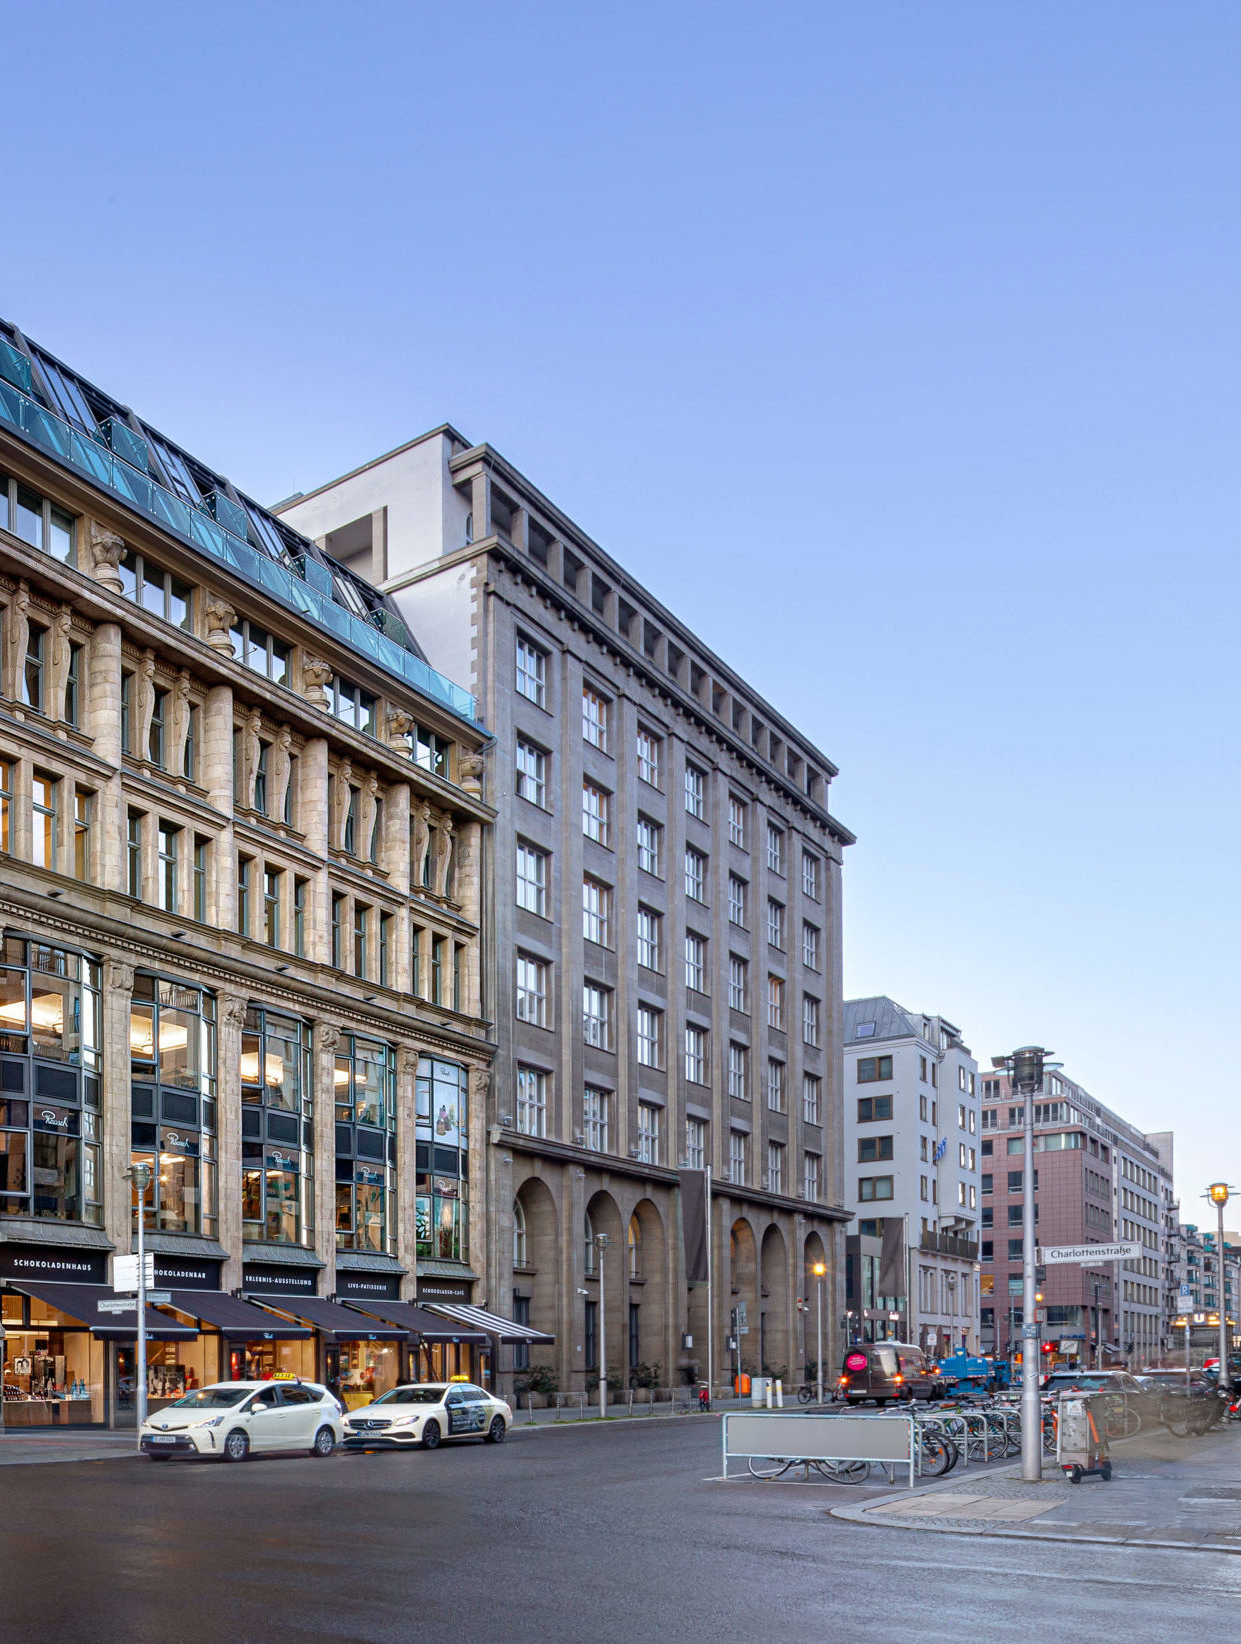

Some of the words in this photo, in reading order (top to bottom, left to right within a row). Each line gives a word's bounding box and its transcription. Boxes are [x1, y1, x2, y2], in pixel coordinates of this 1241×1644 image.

[41, 1110, 69, 1128] Rausch
[166, 1132, 190, 1148] Rausch
[1050, 1245, 1132, 1259] Charlottenstraße
[13, 1259, 92, 1272] SCHOKOLADENHAUS
[245, 1275, 312, 1286] ERLEBNIS-AUSSTELLUNG
